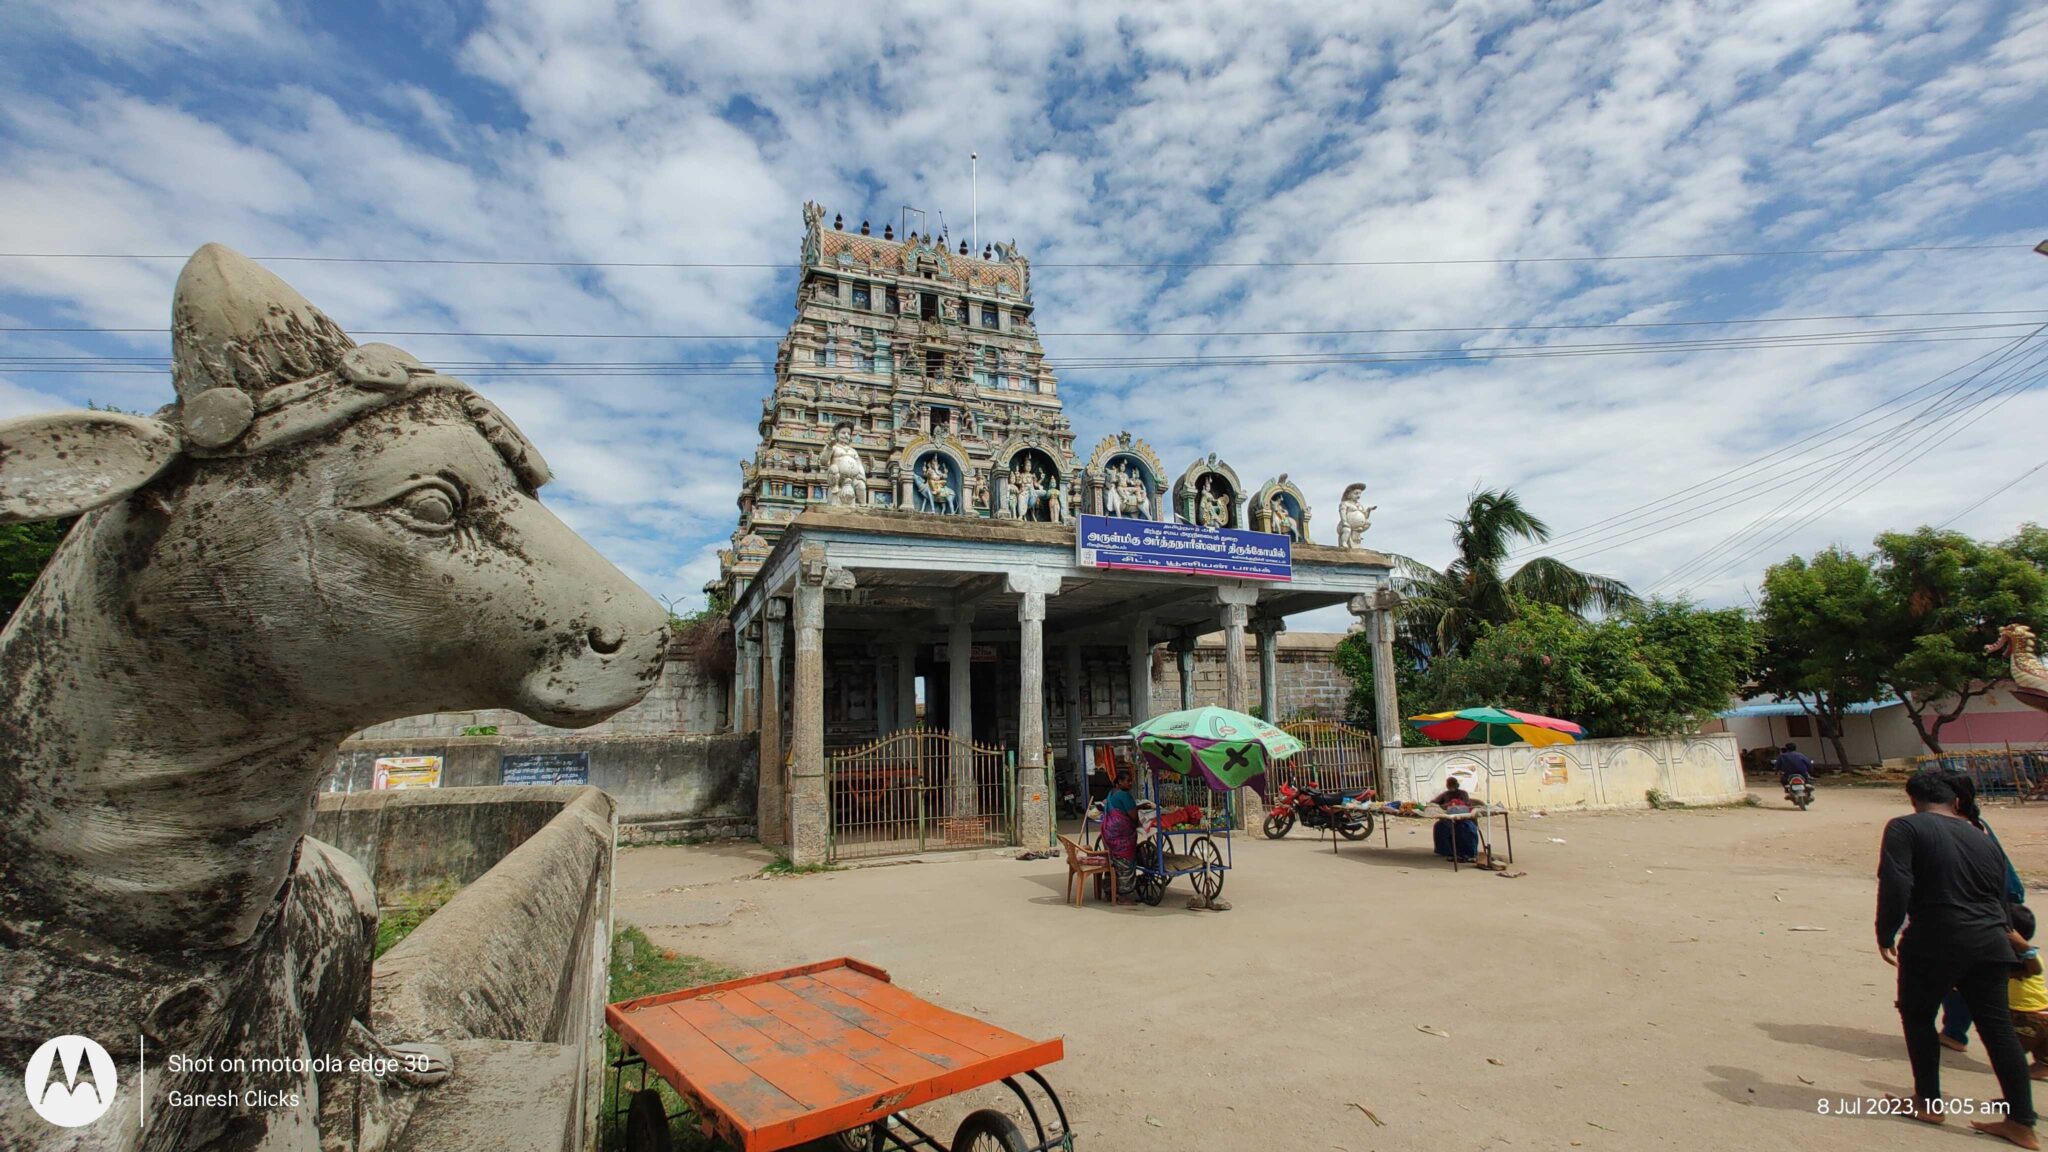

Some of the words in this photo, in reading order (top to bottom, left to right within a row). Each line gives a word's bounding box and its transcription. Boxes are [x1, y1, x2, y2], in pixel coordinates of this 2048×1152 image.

[1087, 531, 1141, 546] அருள்மிகு
[1143, 536, 1227, 552] அர்த்தநாரீஸ்வரர்
[1228, 543, 1286, 558] திருக்கோயில்
[1121, 555, 1160, 566] சிட்டி
